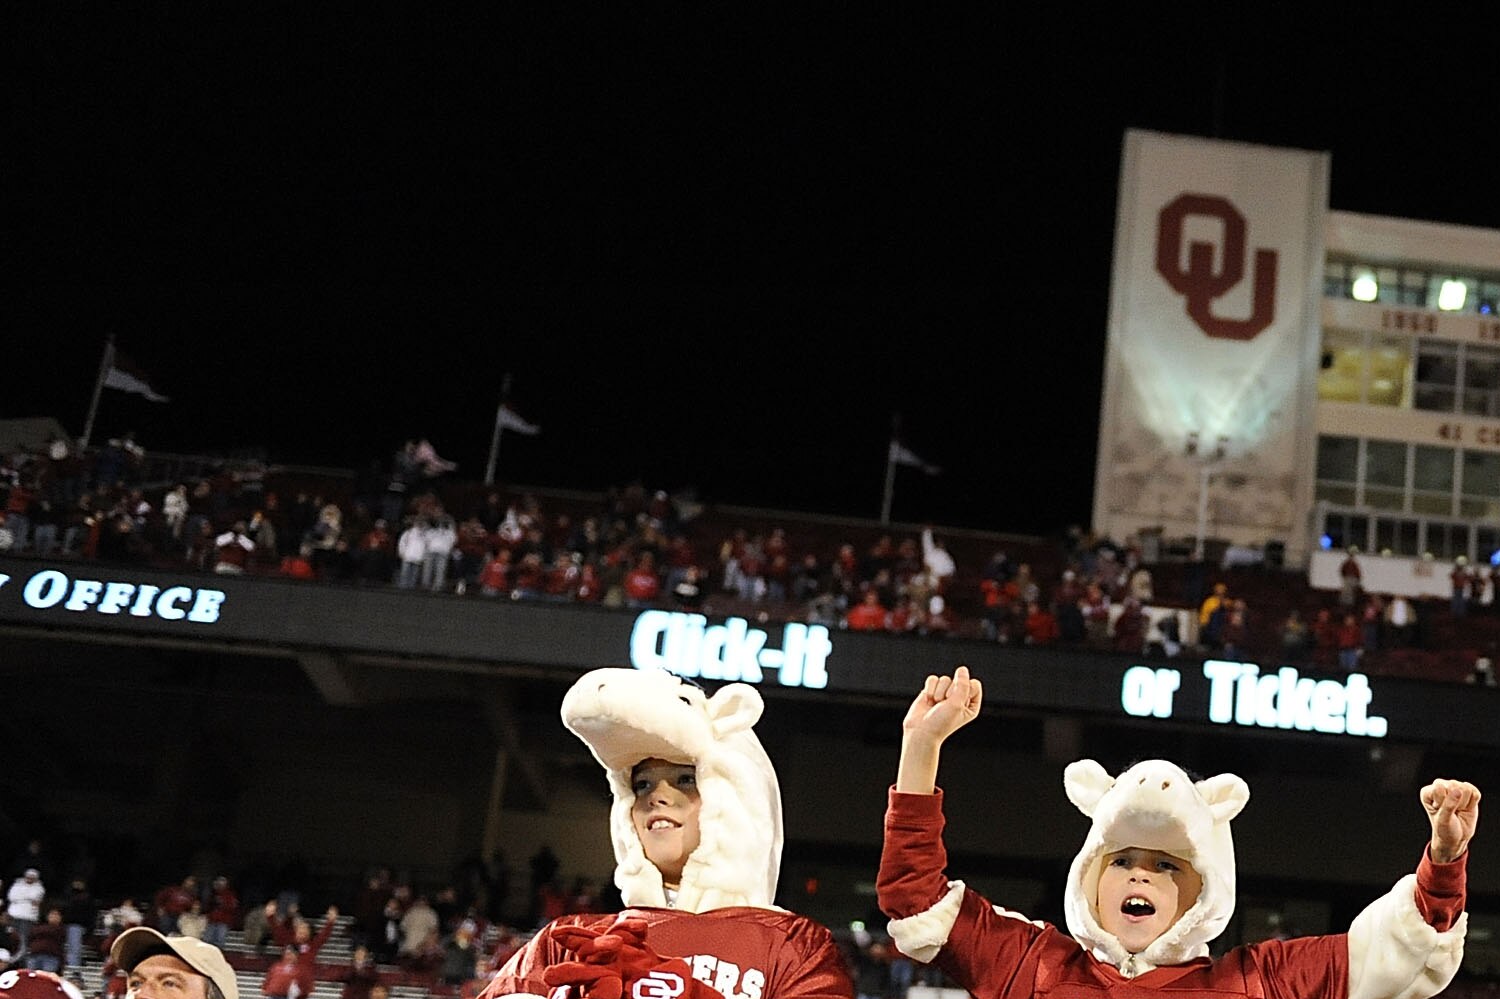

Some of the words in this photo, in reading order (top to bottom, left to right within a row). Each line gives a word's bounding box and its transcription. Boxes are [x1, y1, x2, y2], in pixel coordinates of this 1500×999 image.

[1155, 192, 1278, 341] OU
[1122, 666, 1180, 718] or
[1203, 660, 1388, 737] Ticket.
